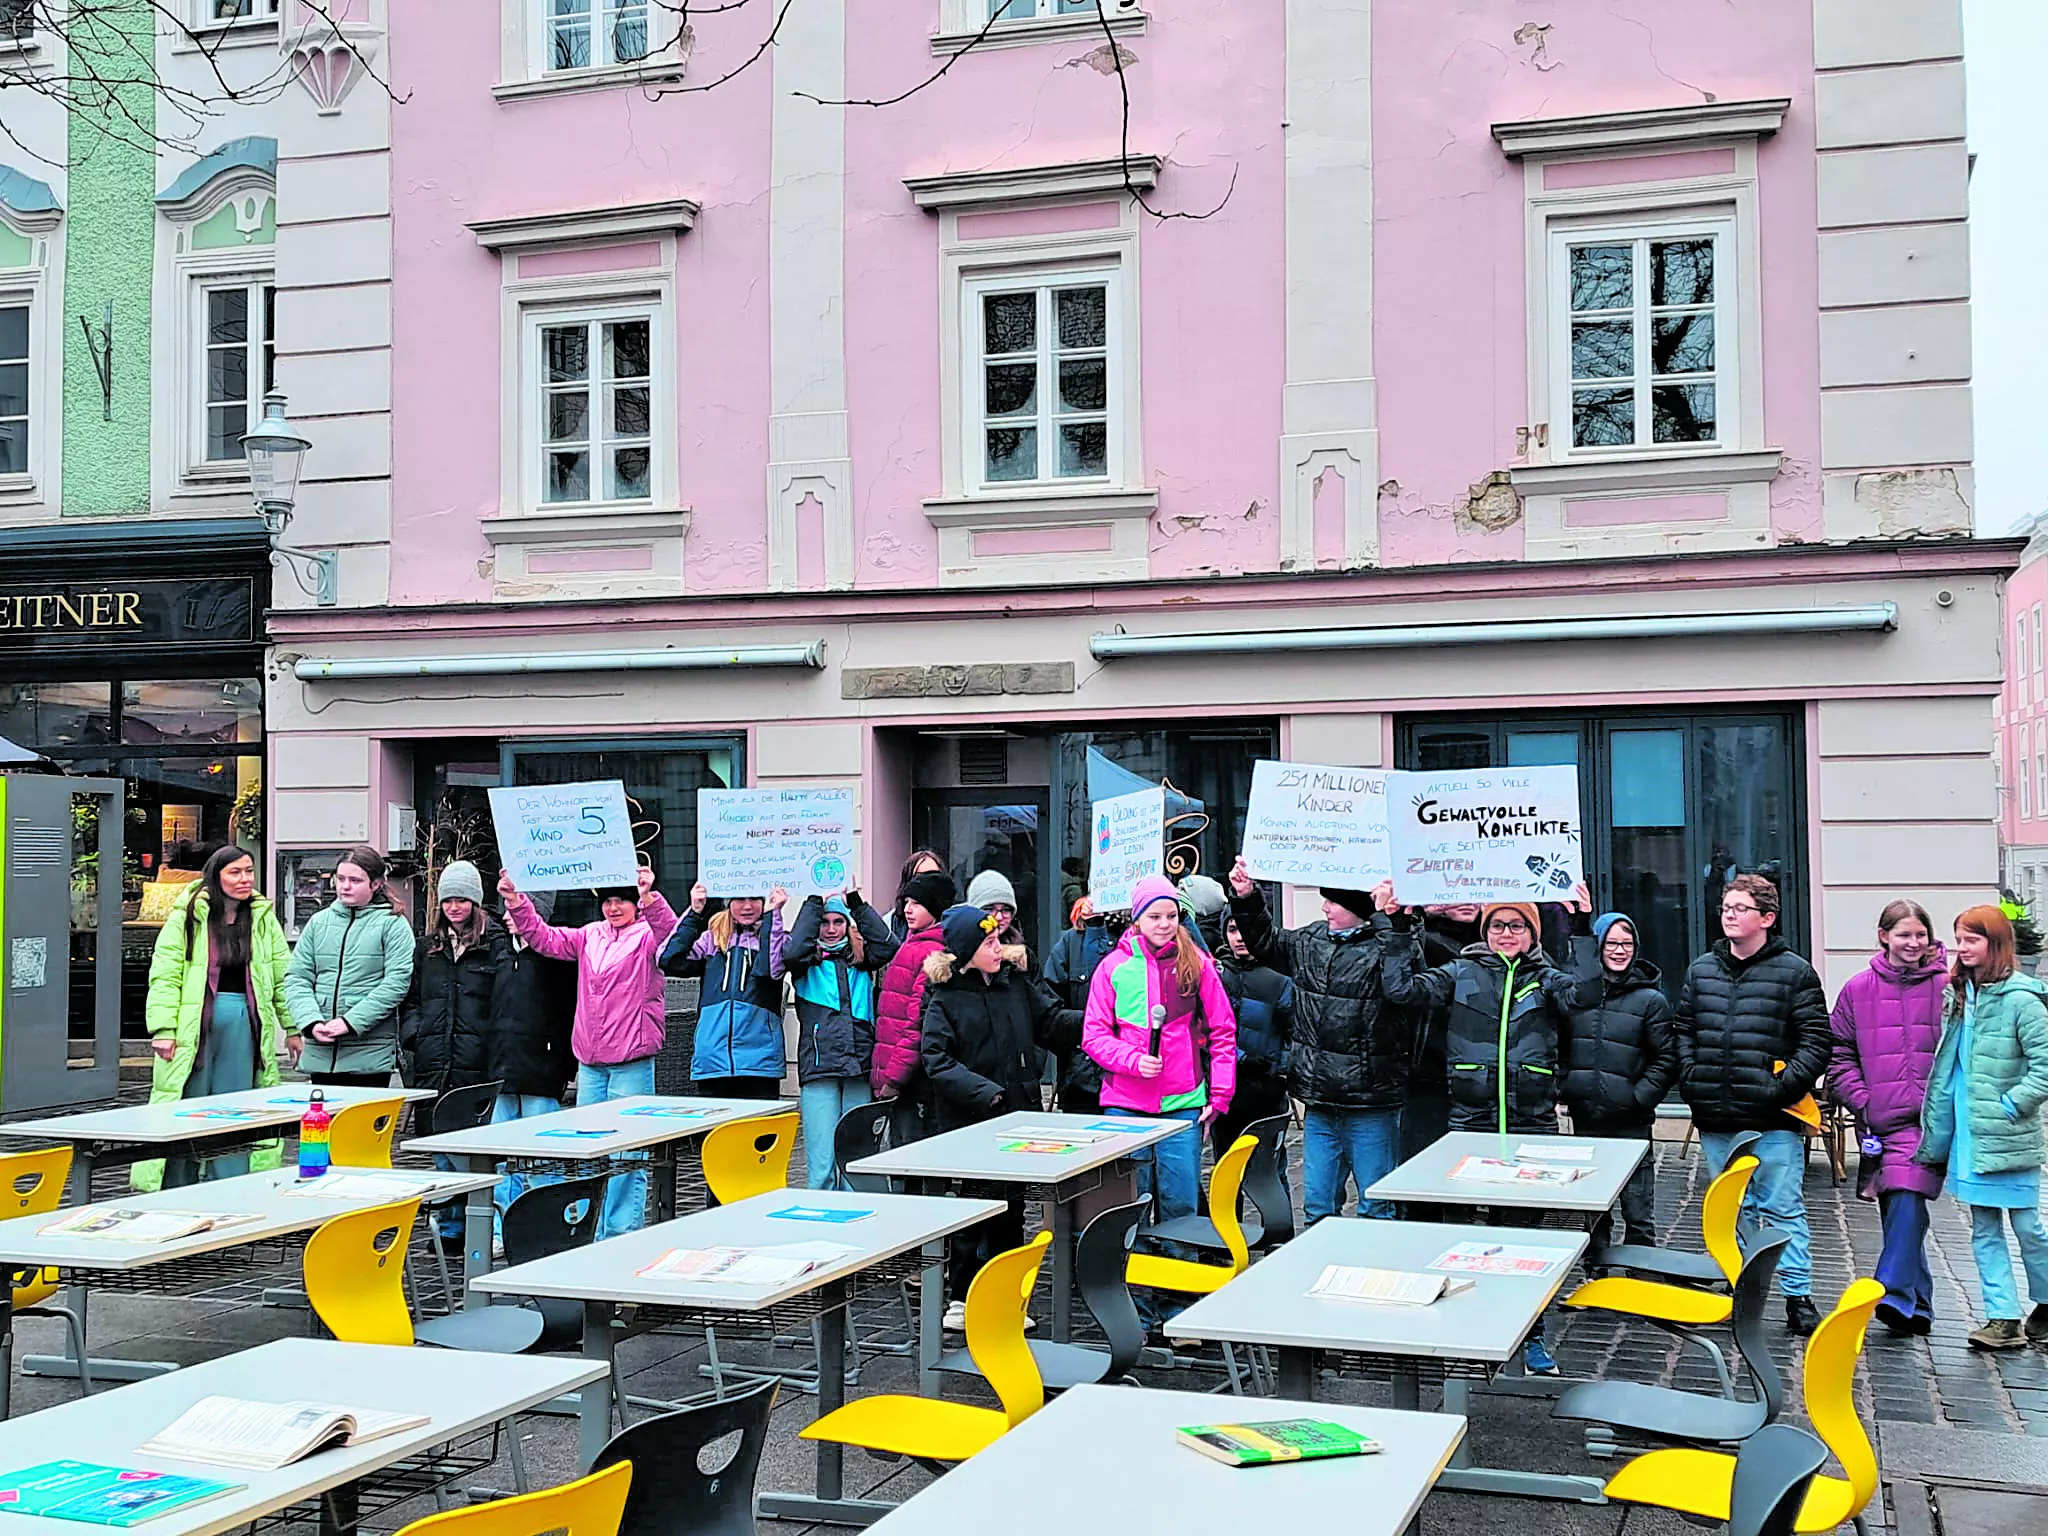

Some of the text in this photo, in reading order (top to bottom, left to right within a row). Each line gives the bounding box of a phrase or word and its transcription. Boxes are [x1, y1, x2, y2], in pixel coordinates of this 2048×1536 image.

[1276, 770, 1308, 788] 251
[1427, 778, 1530, 794] AKTUELL SO VIELE
[517, 794, 613, 811] DER WOHNORT VON
[814, 792, 848, 801] ALLER
[1297, 793, 1353, 813] KINDER
[719, 809, 755, 822] KINDER
[1417, 800, 1538, 825] GEWALTVOLLE
[522, 814, 541, 825] FAST
[577, 806, 607, 835] 5.
[1304, 820, 1358, 831] AUFGRUND
[530, 828, 563, 841] KIND
[746, 829, 775, 839] NICHT
[781, 828, 801, 836] ZUR
[807, 824, 842, 835] SCHULE
[1477, 819, 1570, 838] KONFLIKTE
[516, 839, 620, 859] IST VON BEWAFFNETEN
[714, 843, 744, 852] GEHEN
[1270, 842, 1338, 853] ODER ARMUT
[1457, 841, 1485, 852] SEIT
[1488, 839, 1515, 849] DEM
[731, 853, 796, 865] ENTWICKLUNG
[1406, 857, 1474, 873] ZWEITEN
[527, 861, 593, 877] KONFLIKTEN
[706, 867, 796, 880] GRUNDLEGENDEN
[1287, 860, 1313, 873] ZUR
[1319, 861, 1356, 874] SCHULE
[571, 873, 628, 886] BETROFFEN
[1442, 871, 1521, 889] WELTKRIEG
[712, 882, 755, 892] RECHTEN
